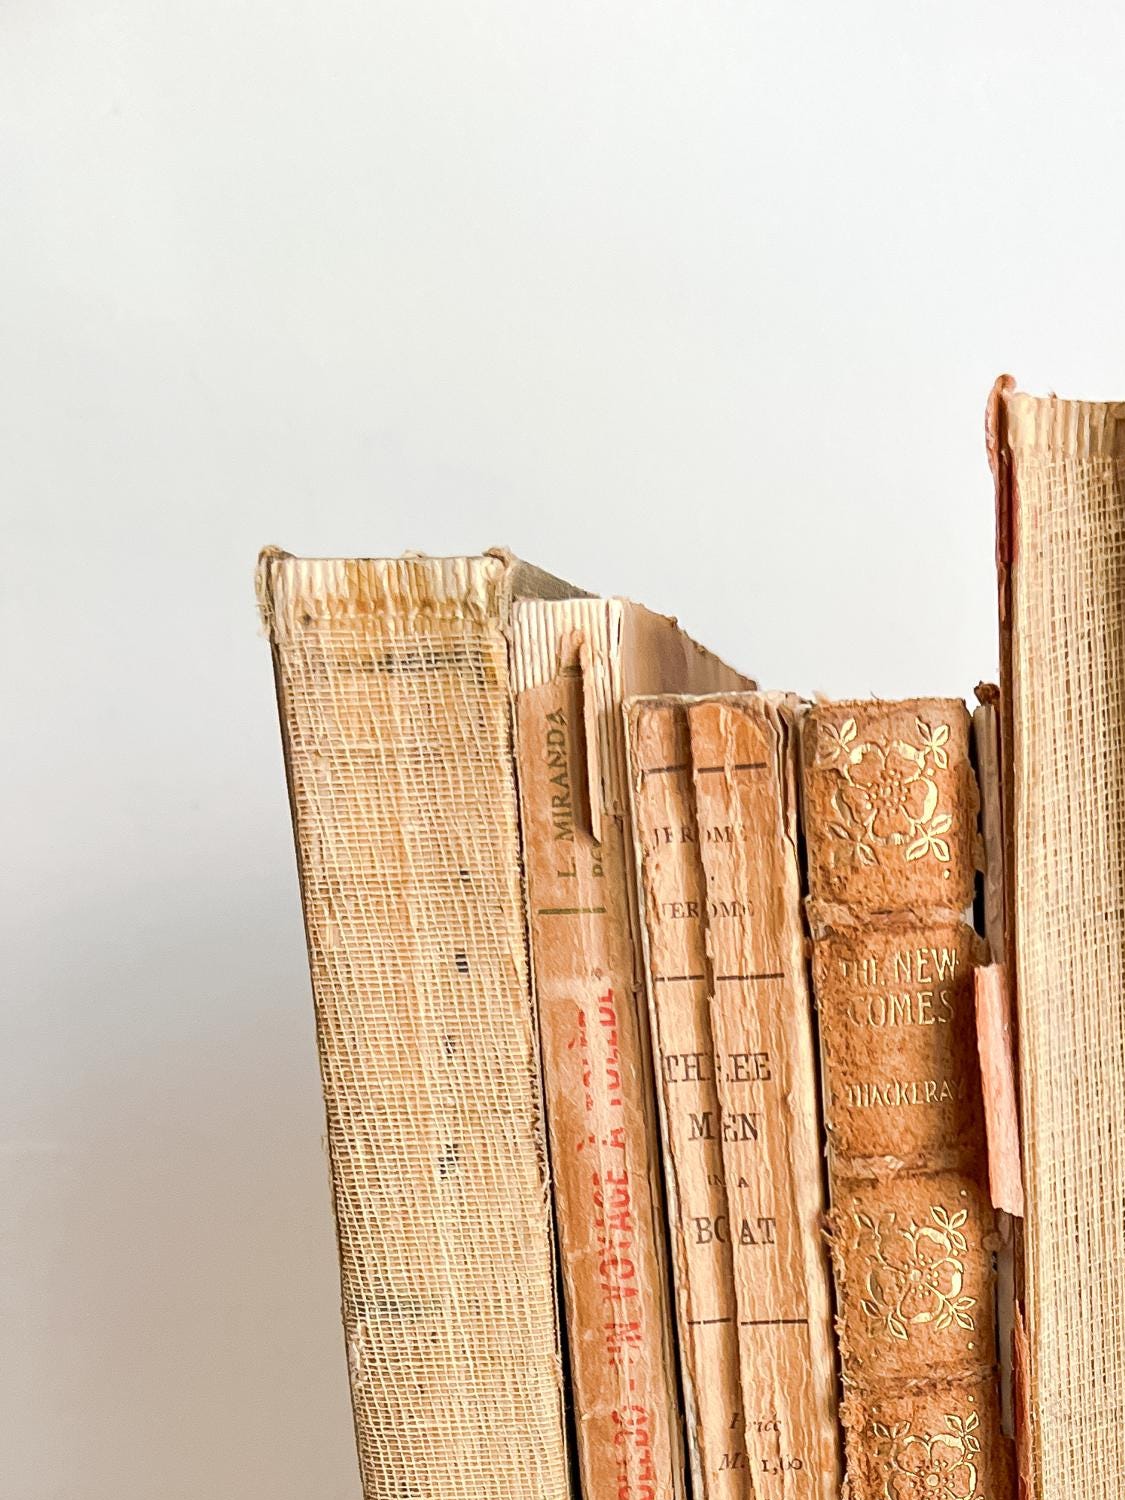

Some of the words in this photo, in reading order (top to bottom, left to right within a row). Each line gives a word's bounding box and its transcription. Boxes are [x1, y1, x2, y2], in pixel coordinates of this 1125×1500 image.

[545, 706, 575, 843] MIRANDA
[847, 991, 954, 1028] COMES
[665, 1052, 771, 1083] THEE
[848, 1080, 966, 1108] THACKERAY
[688, 1111, 760, 1142] MEN
[737, 1176, 749, 1189] A
[592, 1170, 639, 1304] VOYAGE
[692, 1216, 777, 1246] BOAT
[730, 1412, 782, 1432] Pice
